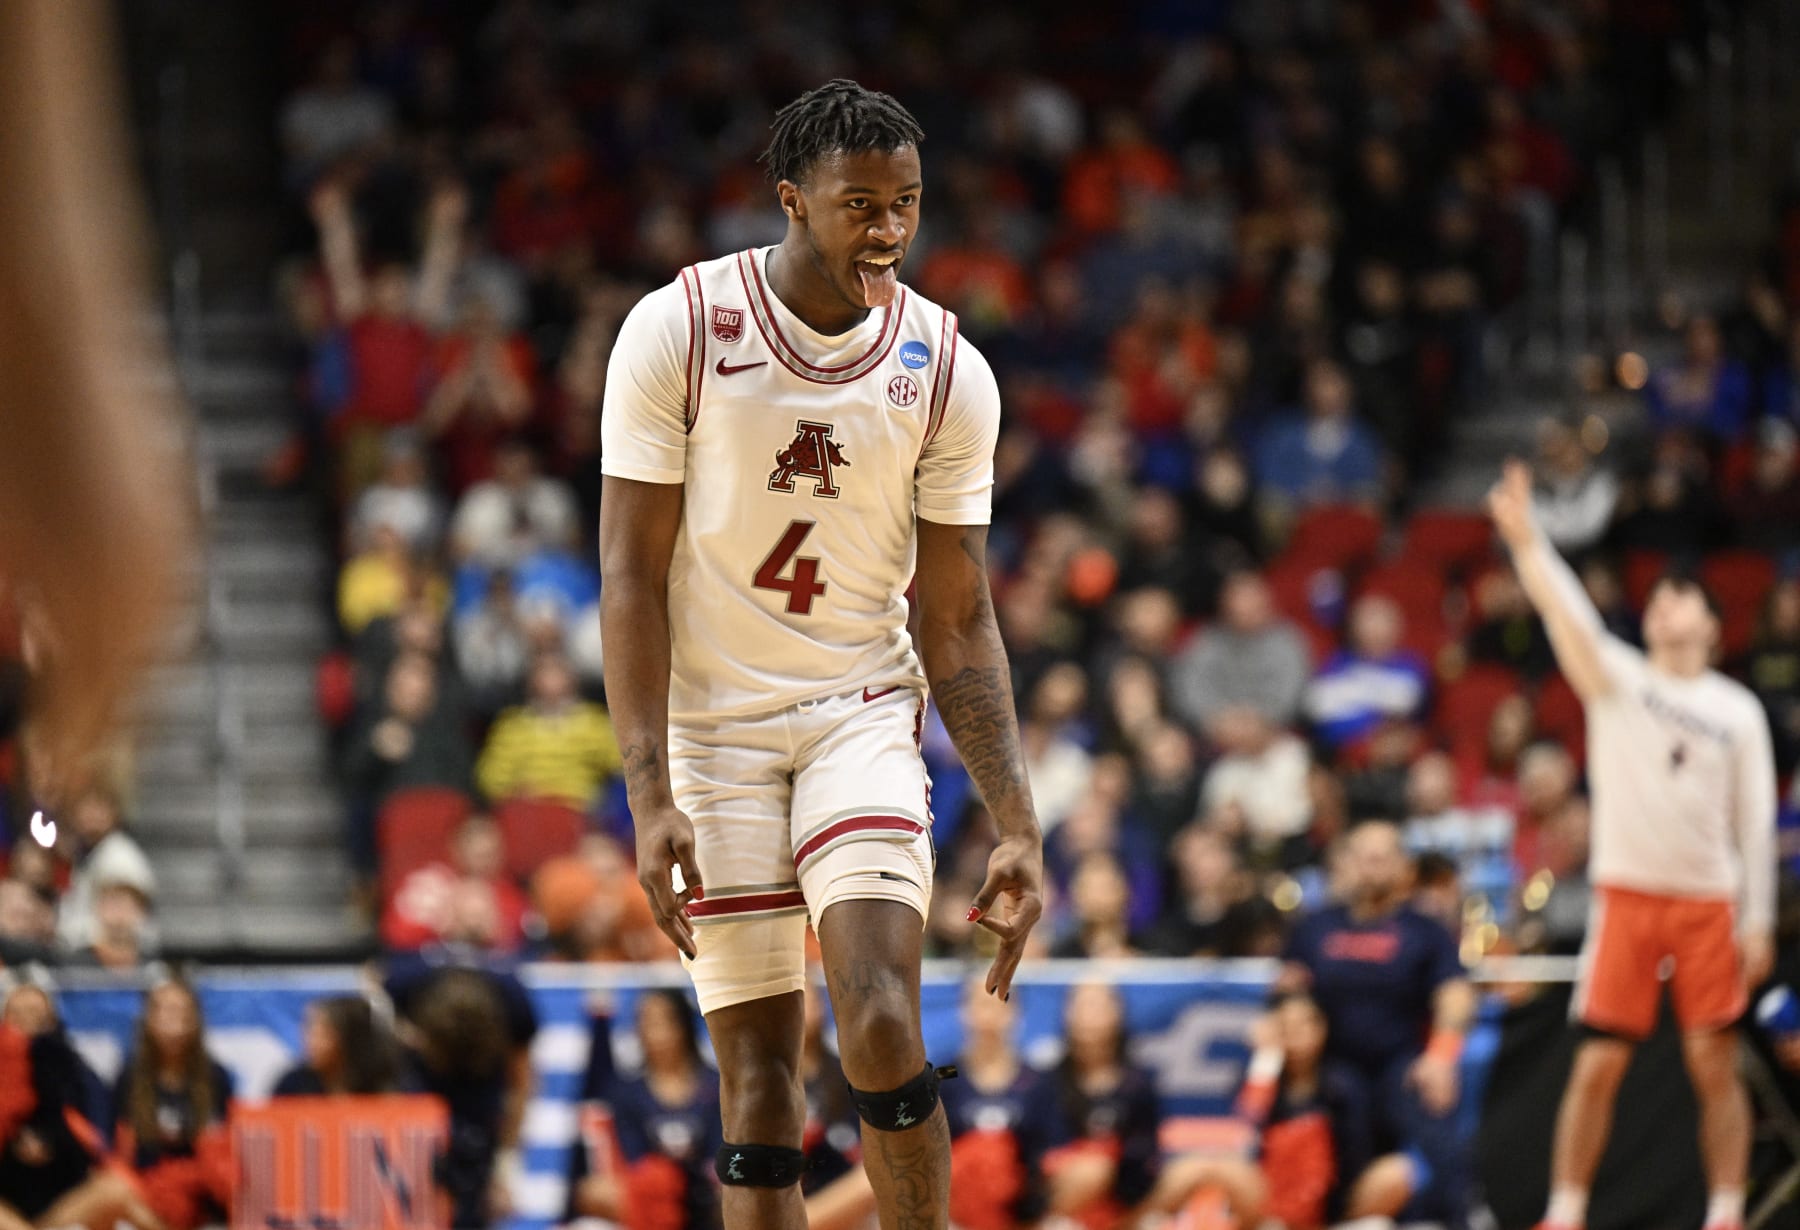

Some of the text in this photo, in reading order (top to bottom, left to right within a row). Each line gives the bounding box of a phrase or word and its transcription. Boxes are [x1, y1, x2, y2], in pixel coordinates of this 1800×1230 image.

[716, 310, 739, 326] 100
[903, 351, 928, 363] NCAA
[889, 376, 917, 405] SEC
[751, 519, 828, 616] 4
